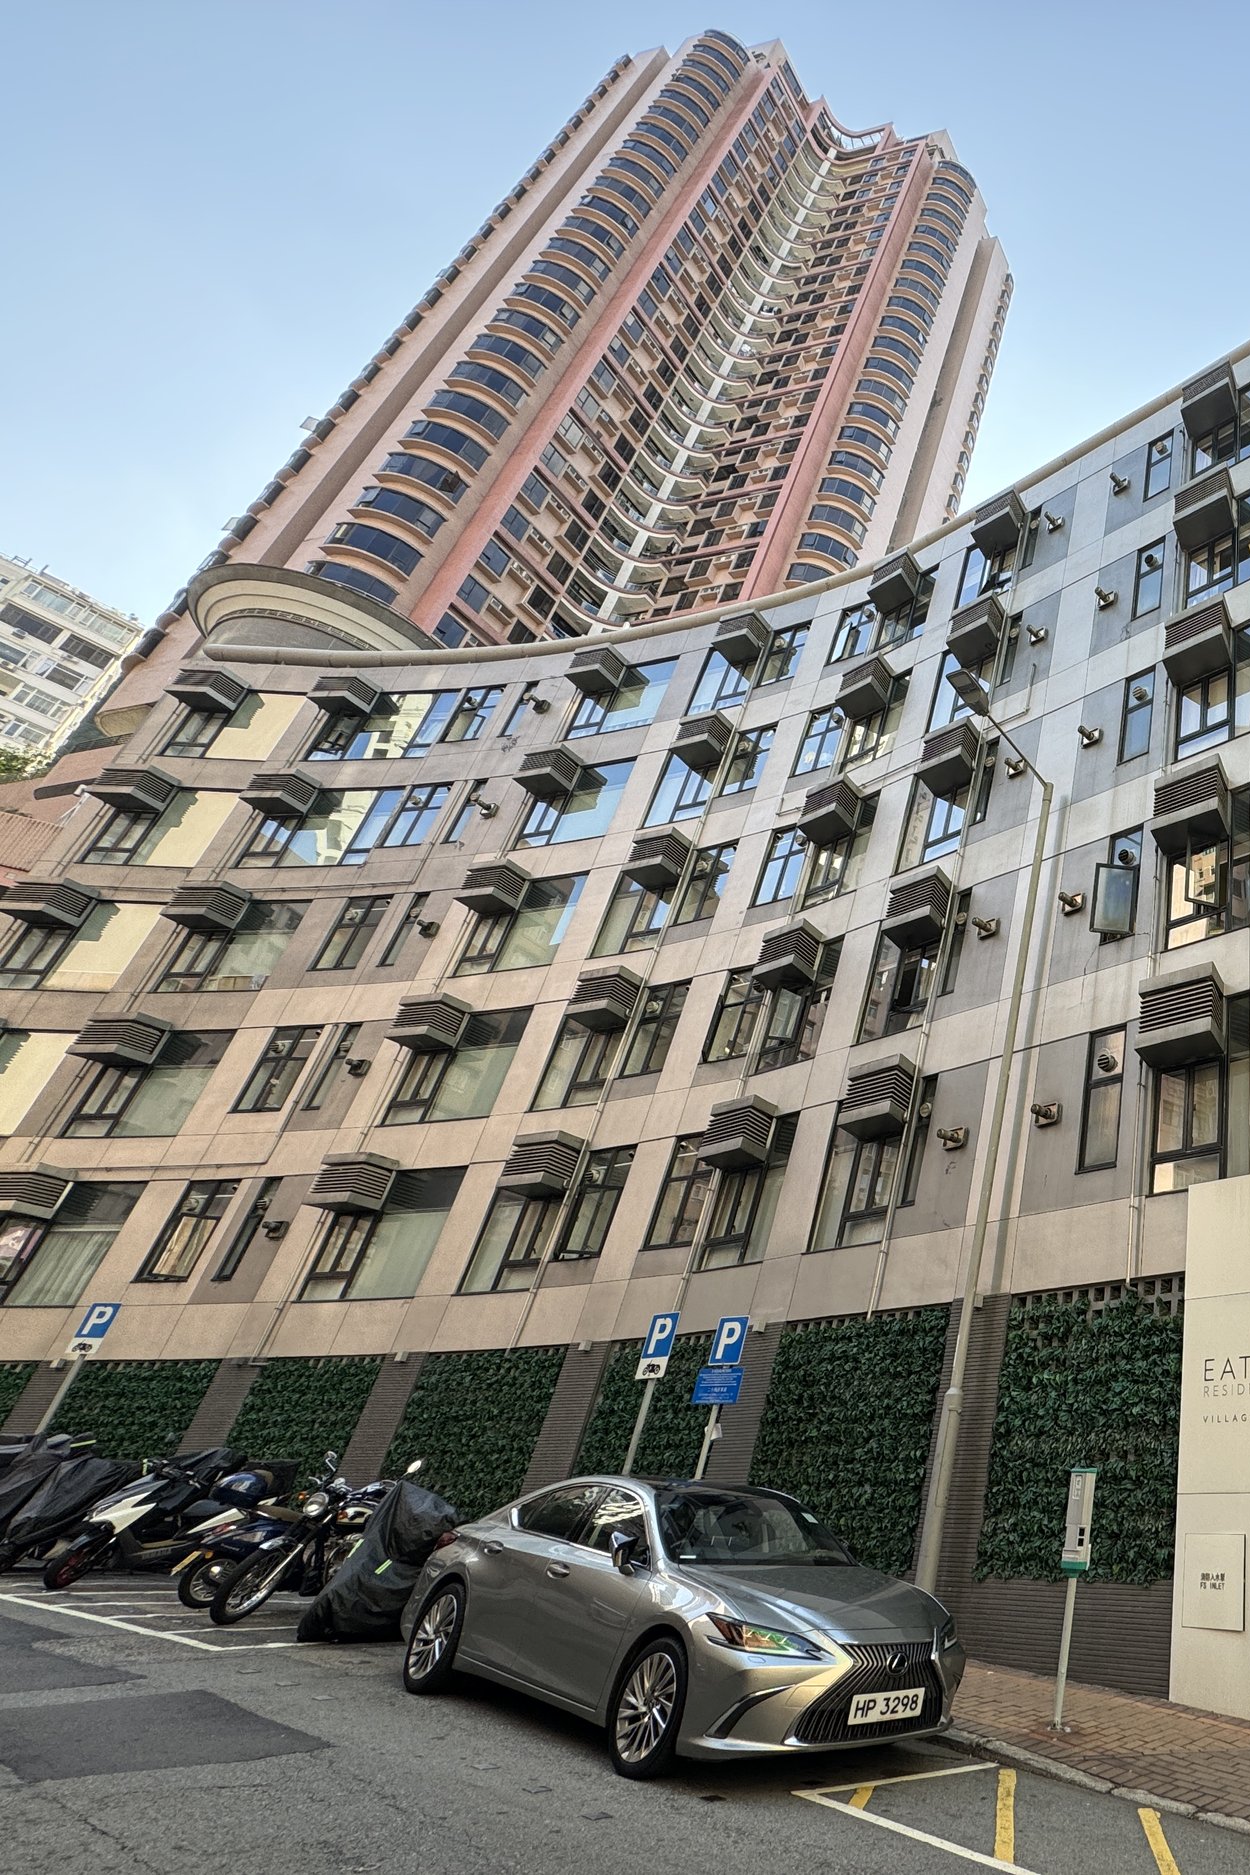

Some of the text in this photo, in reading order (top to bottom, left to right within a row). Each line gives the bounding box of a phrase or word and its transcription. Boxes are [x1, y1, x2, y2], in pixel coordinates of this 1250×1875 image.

[81, 1306, 113, 1335] P
[647, 1317, 673, 1355] P
[715, 1321, 742, 1360] P
[853, 1693, 919, 1719] HP 3298
